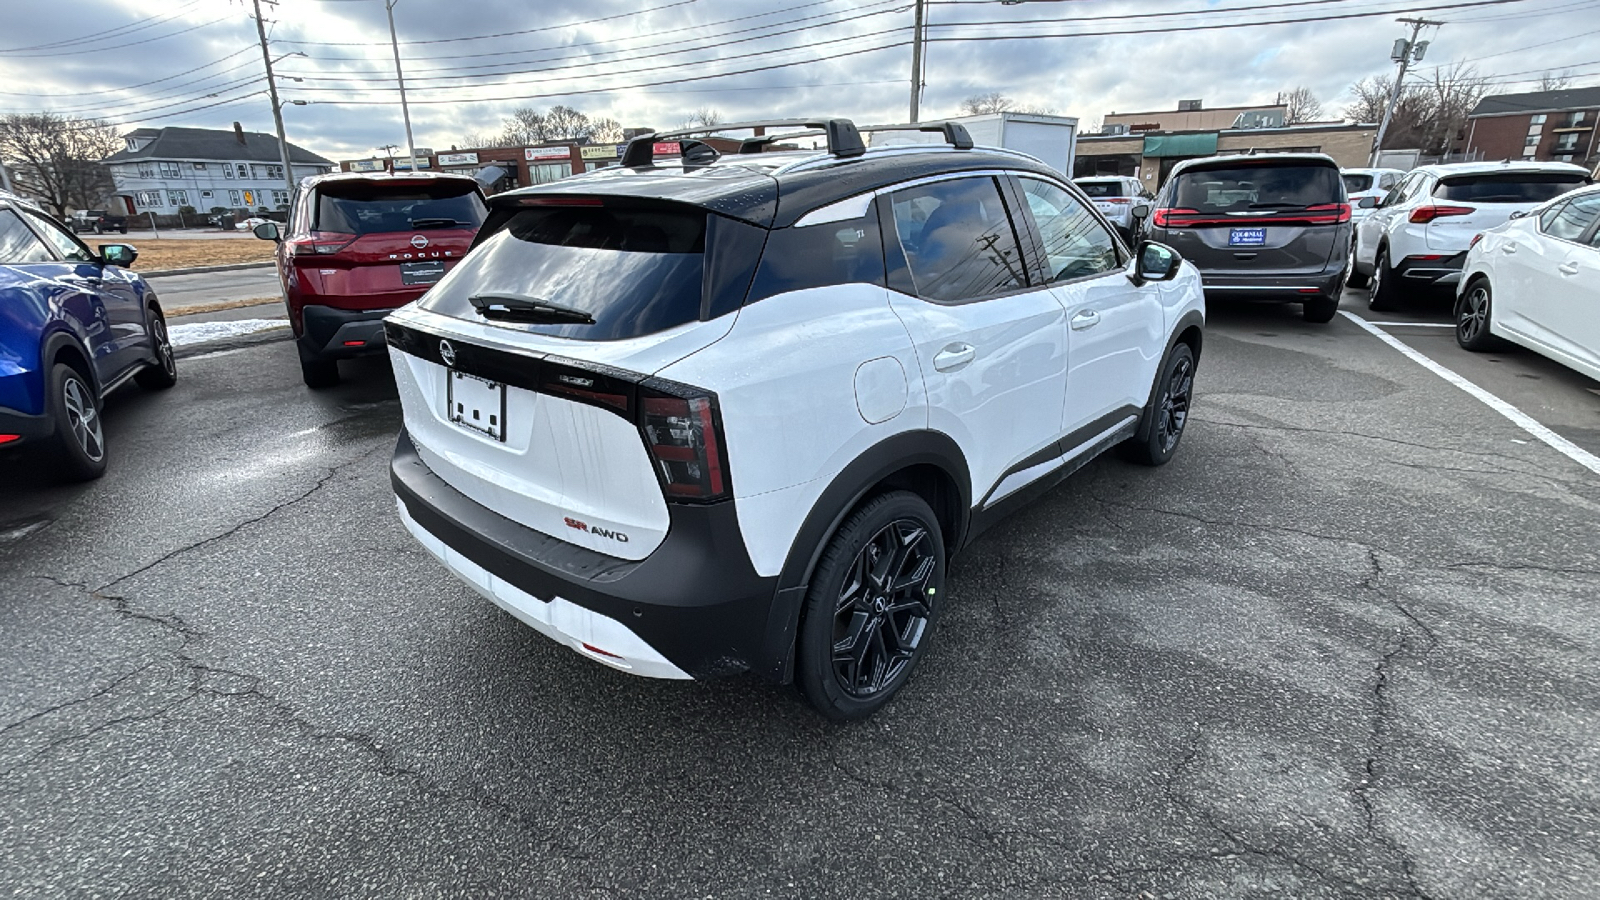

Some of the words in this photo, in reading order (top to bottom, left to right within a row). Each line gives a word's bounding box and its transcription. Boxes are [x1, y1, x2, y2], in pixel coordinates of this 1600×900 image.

[389, 251, 452, 259] ROGUE
[564, 516, 590, 533] SR
[591, 526, 629, 543] AWD
